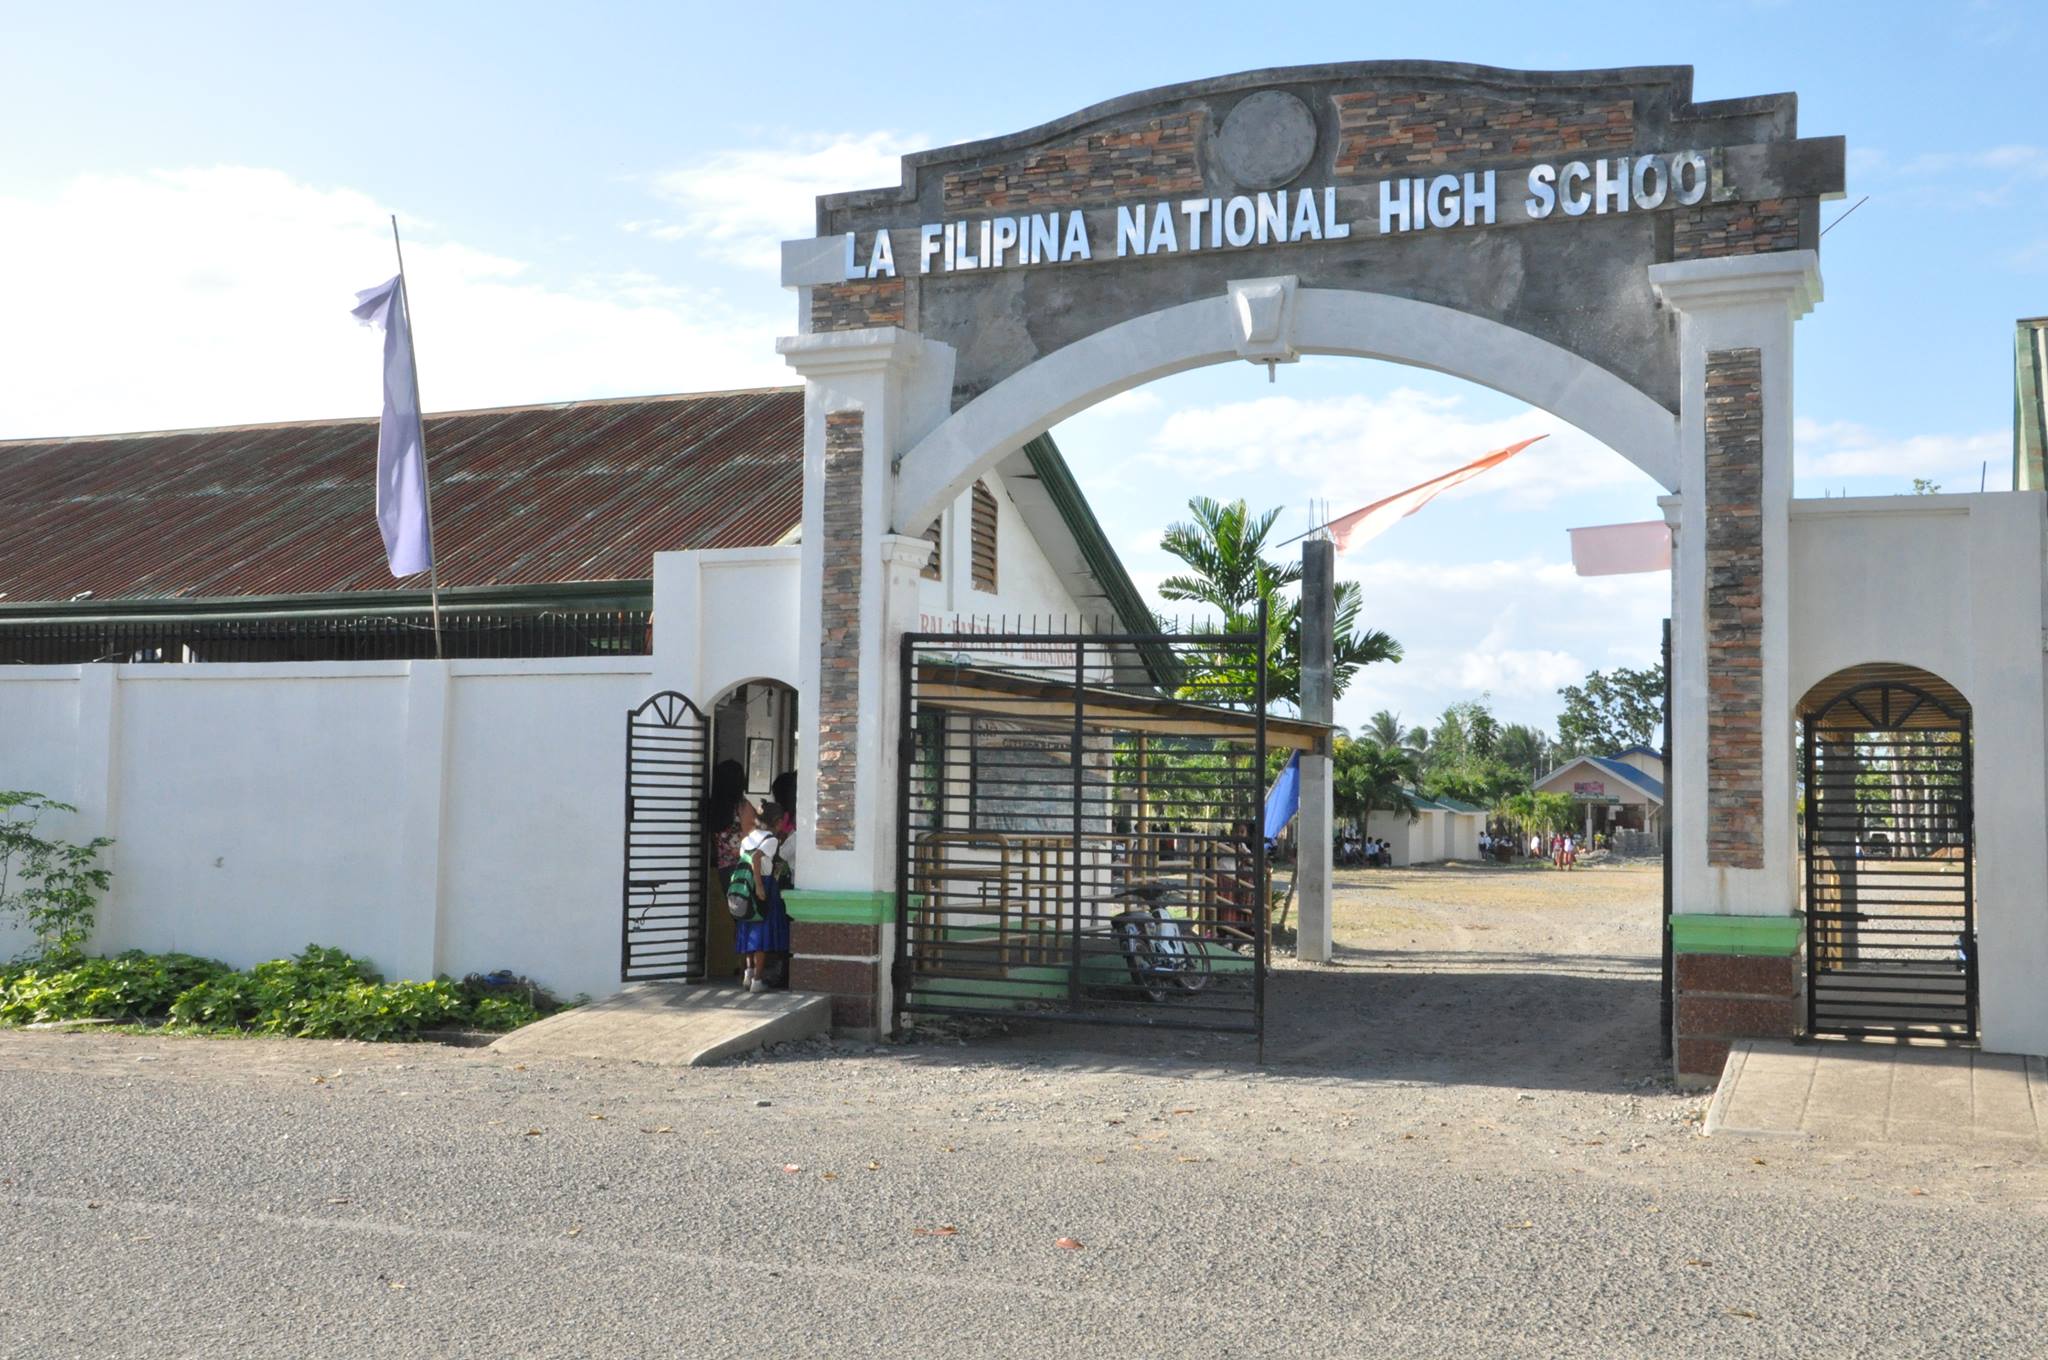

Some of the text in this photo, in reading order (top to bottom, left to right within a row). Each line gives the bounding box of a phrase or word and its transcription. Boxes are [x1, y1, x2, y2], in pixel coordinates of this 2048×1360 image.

[846, 228, 896, 280] LA
[920, 210, 1092, 274] FILIPINA
[1117, 187, 1350, 257] NATIONAL
[1379, 169, 1496, 234] HIGH
